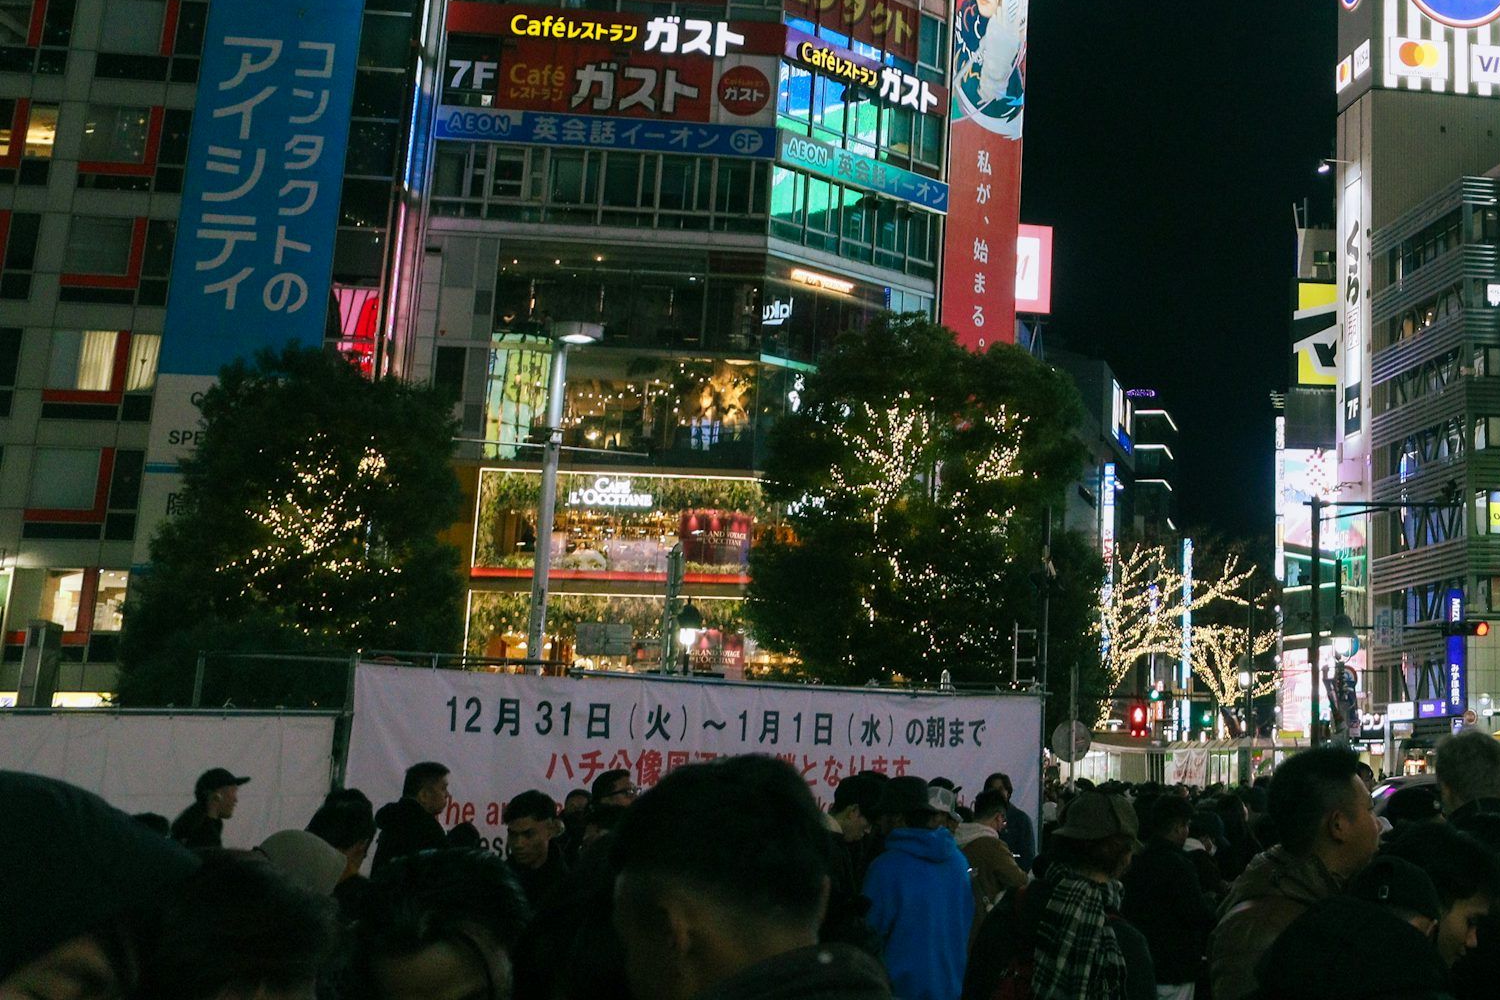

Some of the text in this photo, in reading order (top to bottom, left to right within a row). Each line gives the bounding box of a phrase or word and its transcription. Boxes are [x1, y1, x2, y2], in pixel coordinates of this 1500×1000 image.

[644, 17, 745, 57] ガスト
[450, 60, 498, 88] 7F
[571, 62, 698, 113] ガスト
[724, 87, 764, 102] ガスト
[880, 67, 938, 114] ガスト
[449, 116, 511, 134] AEON
[532, 116, 720, 148] 英会話イーオン
[734, 133, 759, 150] 6F
[787, 138, 828, 167] AEON
[195, 36, 283, 310] アイシティ
[263, 41, 336, 314] コンタクトの
[838, 154, 946, 205] 英会話イーオン
[1347, 396, 1359, 420] 7F
